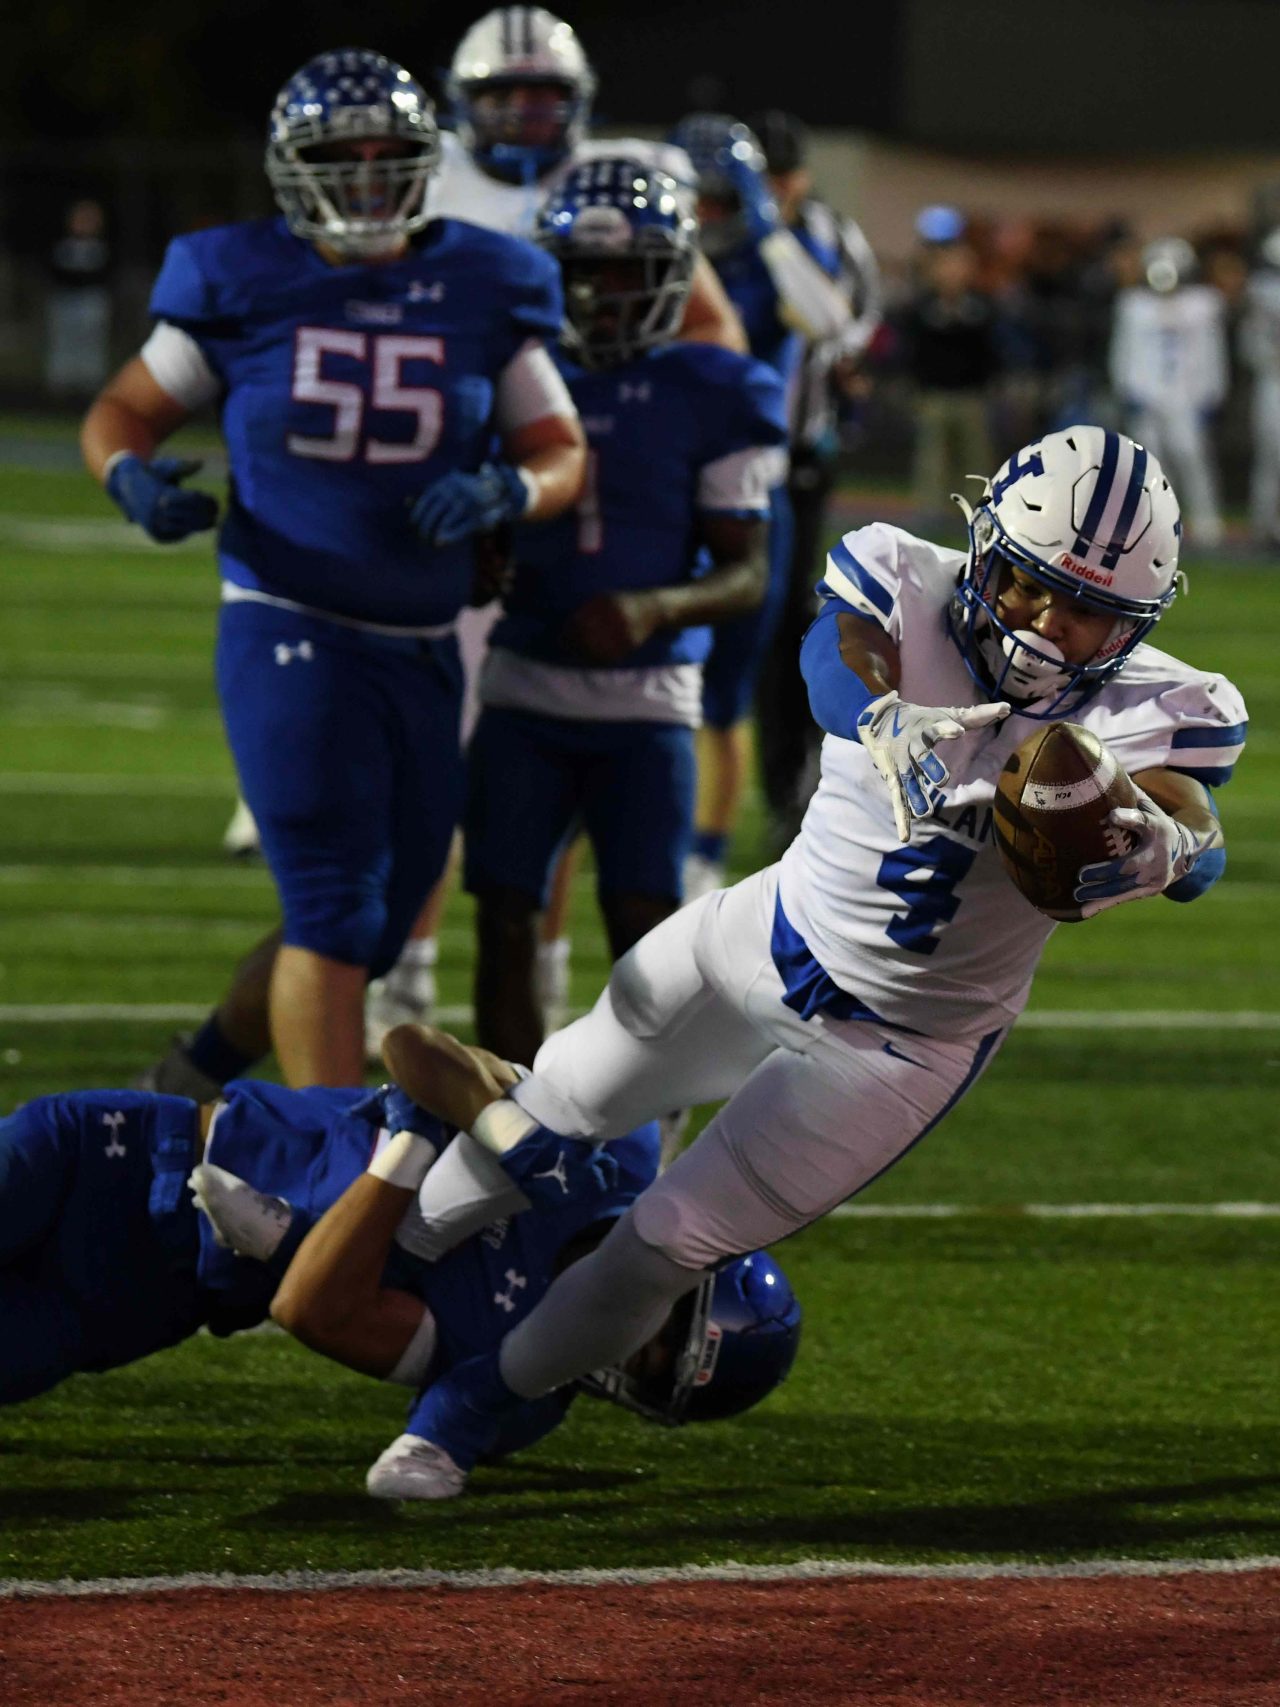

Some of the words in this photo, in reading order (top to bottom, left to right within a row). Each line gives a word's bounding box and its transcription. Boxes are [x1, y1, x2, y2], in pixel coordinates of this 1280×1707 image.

[288, 326, 445, 464] 55
[1061, 552, 1113, 587] Riddell
[1097, 635, 1131, 659] Ridde
[876, 834, 978, 957] 4
